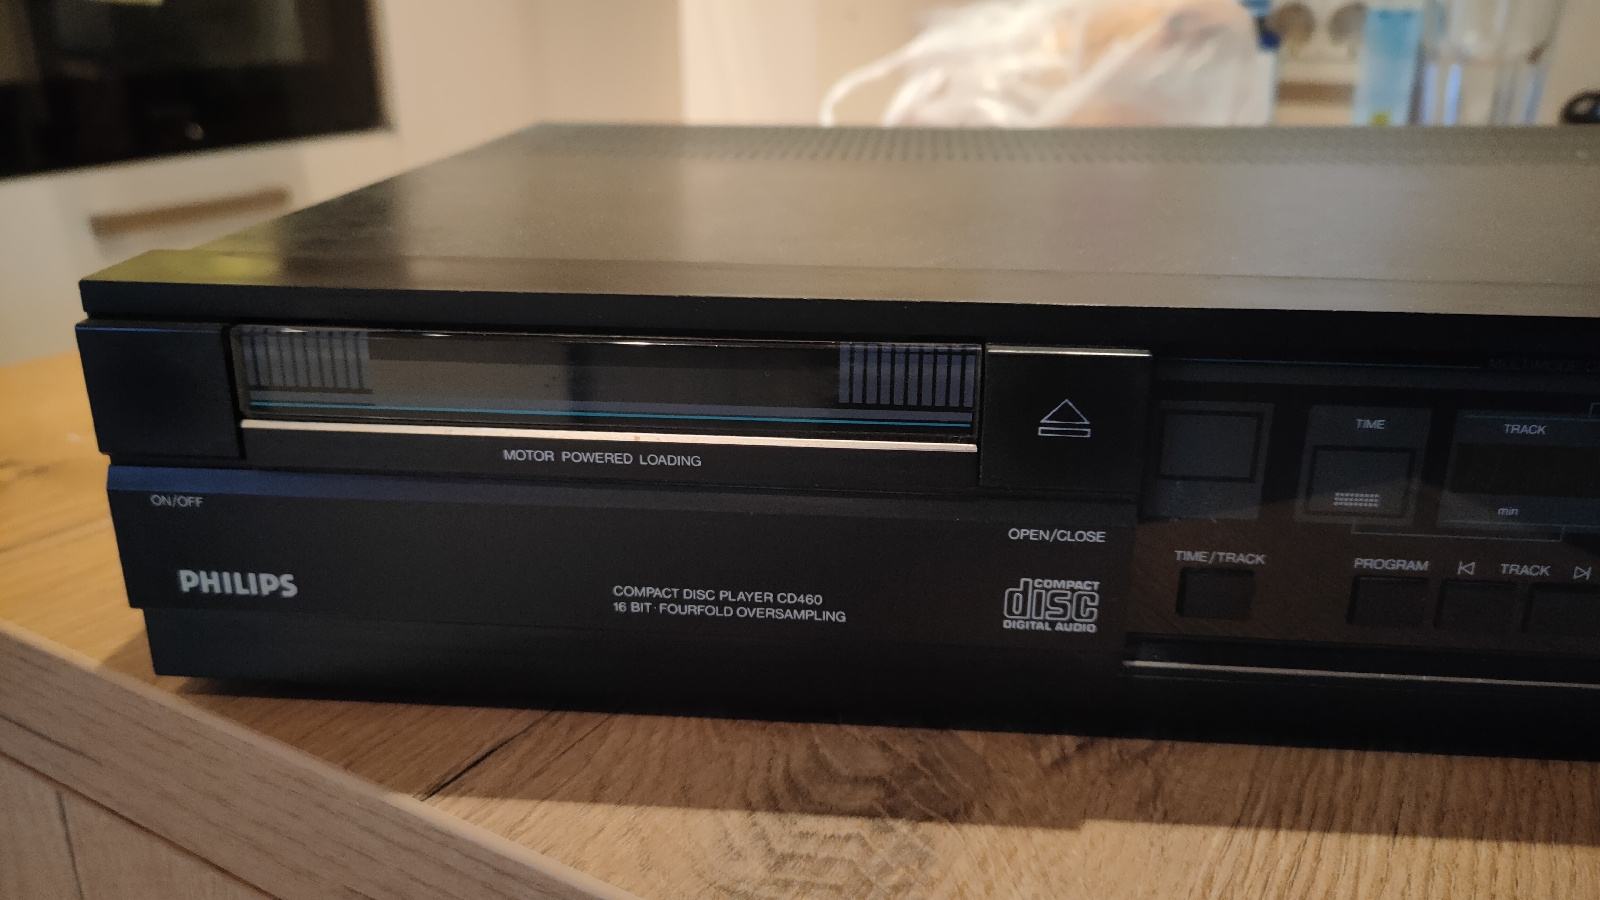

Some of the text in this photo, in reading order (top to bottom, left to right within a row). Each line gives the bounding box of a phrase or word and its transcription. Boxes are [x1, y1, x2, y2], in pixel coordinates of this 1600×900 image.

[1355, 417, 1386, 430] TIME
[1504, 423, 1547, 436] TRACK
[503, 449, 702, 467] MOTOR POWERED LOADING
[150, 494, 205, 508] ON/OFF
[1497, 505, 1520, 517] min
[1008, 527, 1106, 543] OPEN/CLOSE
[1174, 550, 1267, 565] TIME/TRACK
[1353, 557, 1430, 572] PROGRAM
[1500, 563, 1551, 577] TRACK
[177, 568, 299, 599] PHILIPS
[1033, 578, 1101, 591] COMPACT
[612, 585, 823, 606] COMPACT DISC PLAYER CD460
[613, 601, 627, 613] 16
[659, 602, 734, 617] FOURFOLD
[736, 606, 847, 623] OVERSAMPLING
[1002, 619, 1098, 634] DIGITAL AUDIO
